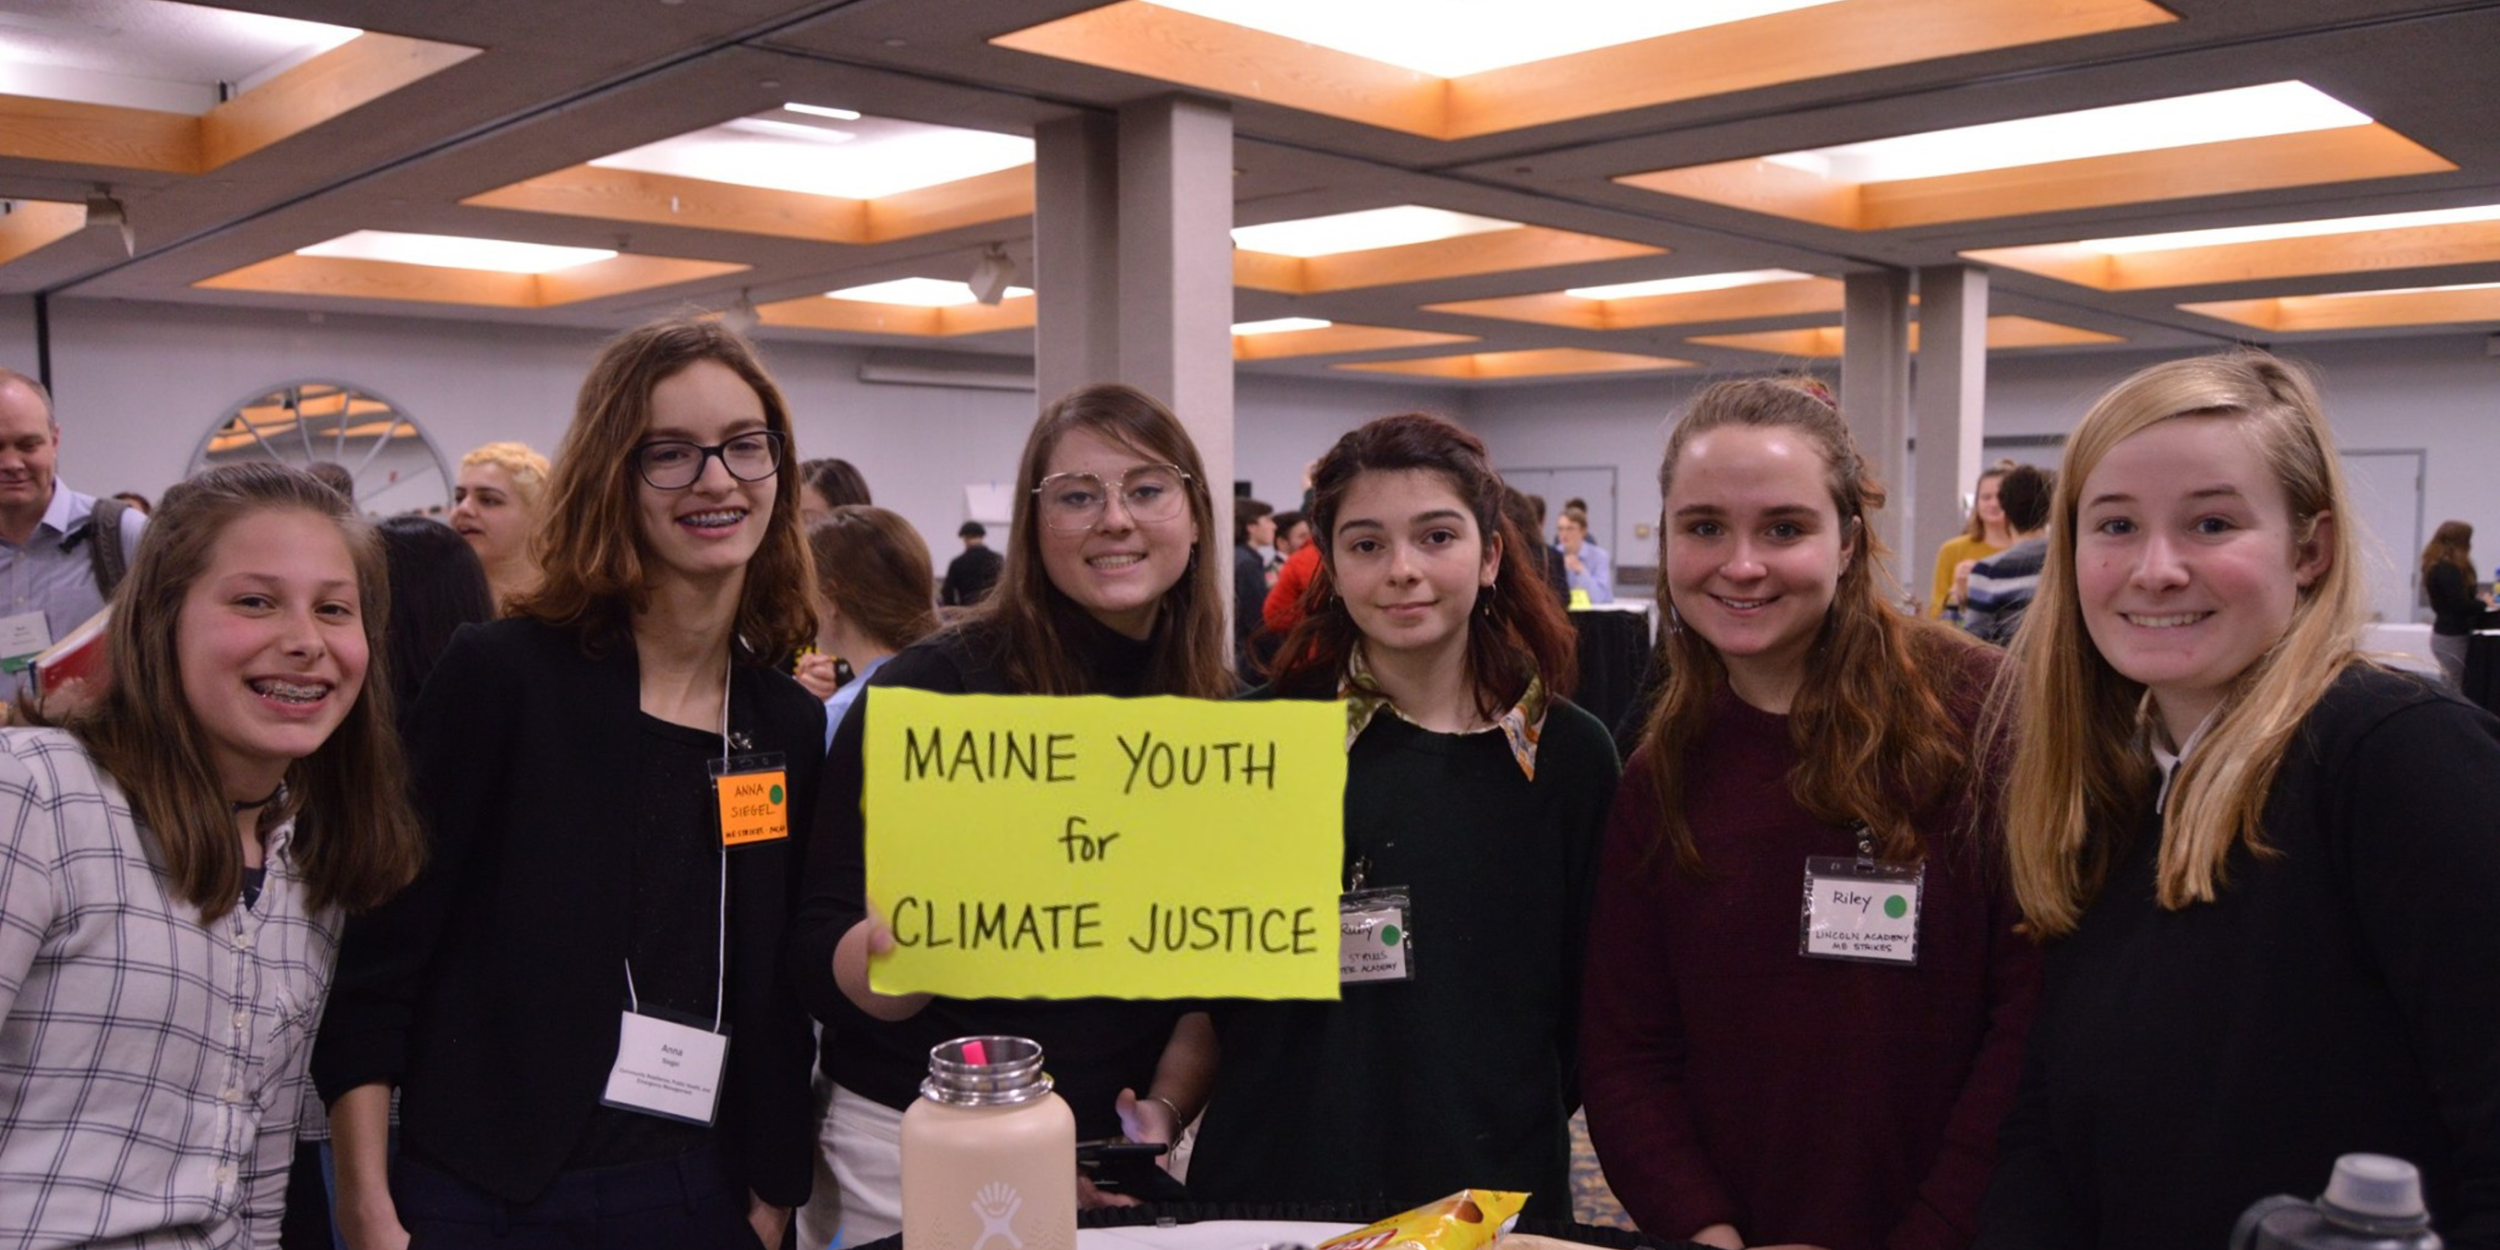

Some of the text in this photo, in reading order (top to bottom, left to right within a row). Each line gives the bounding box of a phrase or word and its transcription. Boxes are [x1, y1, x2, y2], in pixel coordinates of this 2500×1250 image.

[904, 727, 1276, 795] MAINE YOUTH
[734, 783, 764, 797] ANNA
[731, 803, 775, 818] SIEGEL
[1059, 816, 1119, 863] for
[1833, 890, 1872, 914] Riley
[891, 896, 1316, 955] CLIMATE JUSTICE
[1340, 921, 1373, 941] Ruby
[1816, 930, 1909, 943] LINCOLN ACADEMY
[1853, 942, 1892, 953] STRIKES
[661, 1044, 682, 1056] Anna
